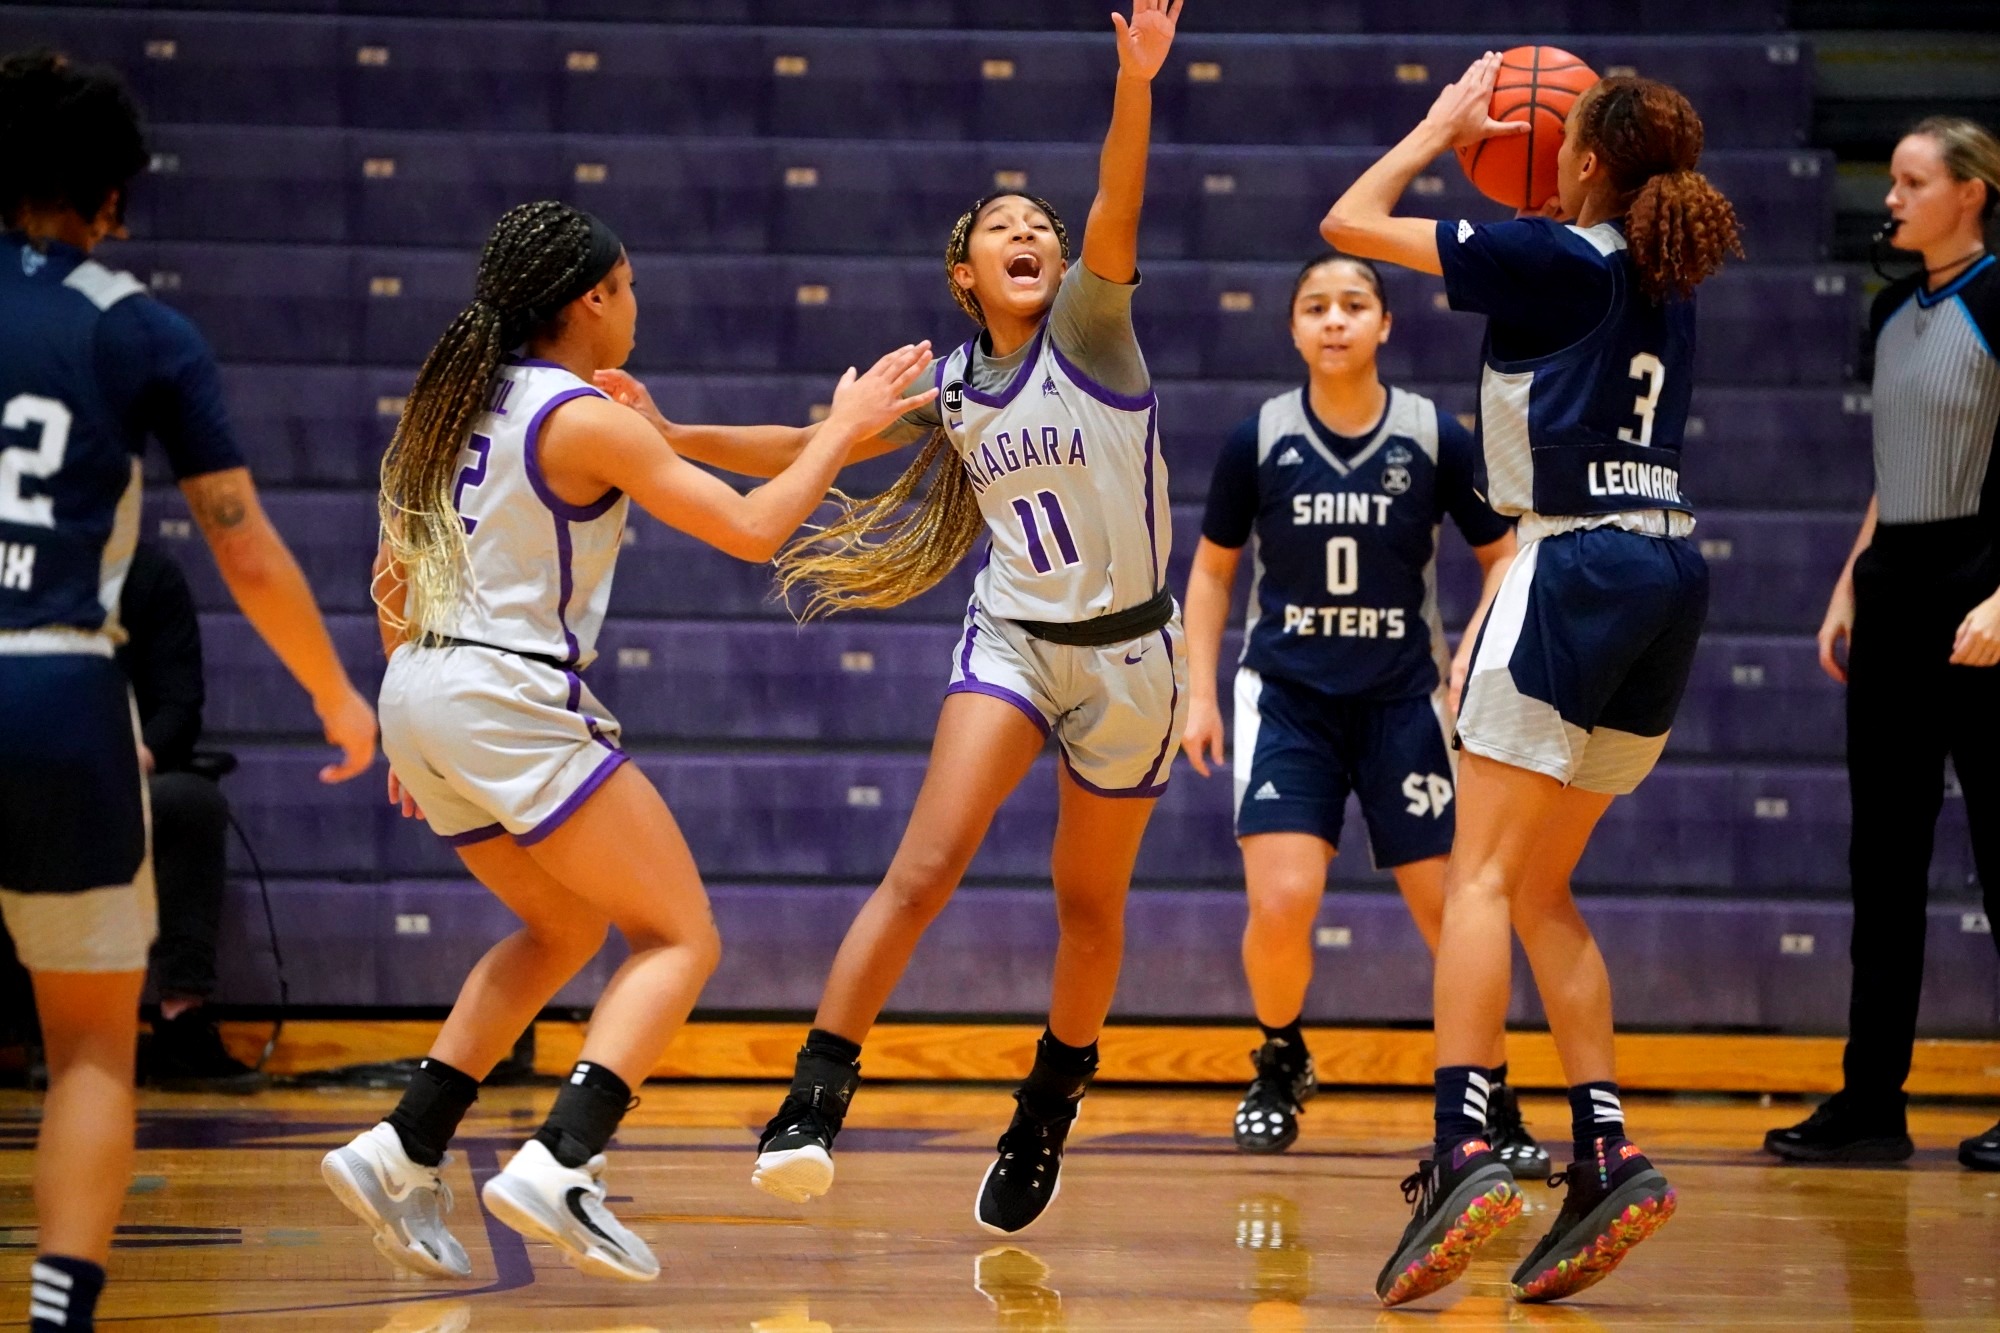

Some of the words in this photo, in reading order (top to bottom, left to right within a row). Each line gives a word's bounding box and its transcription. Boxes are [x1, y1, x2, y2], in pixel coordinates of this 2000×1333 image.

[1617, 352, 1666, 447] 3
[0, 392, 73, 529] 2
[963, 425, 1088, 494] NIAGARA
[1008, 488, 1083, 577] 11
[1292, 492, 1393, 526] SAINT
[1326, 536, 1358, 595] 0
[1283, 603, 1406, 639] PETER'S
[1401, 772, 1454, 819] SP
